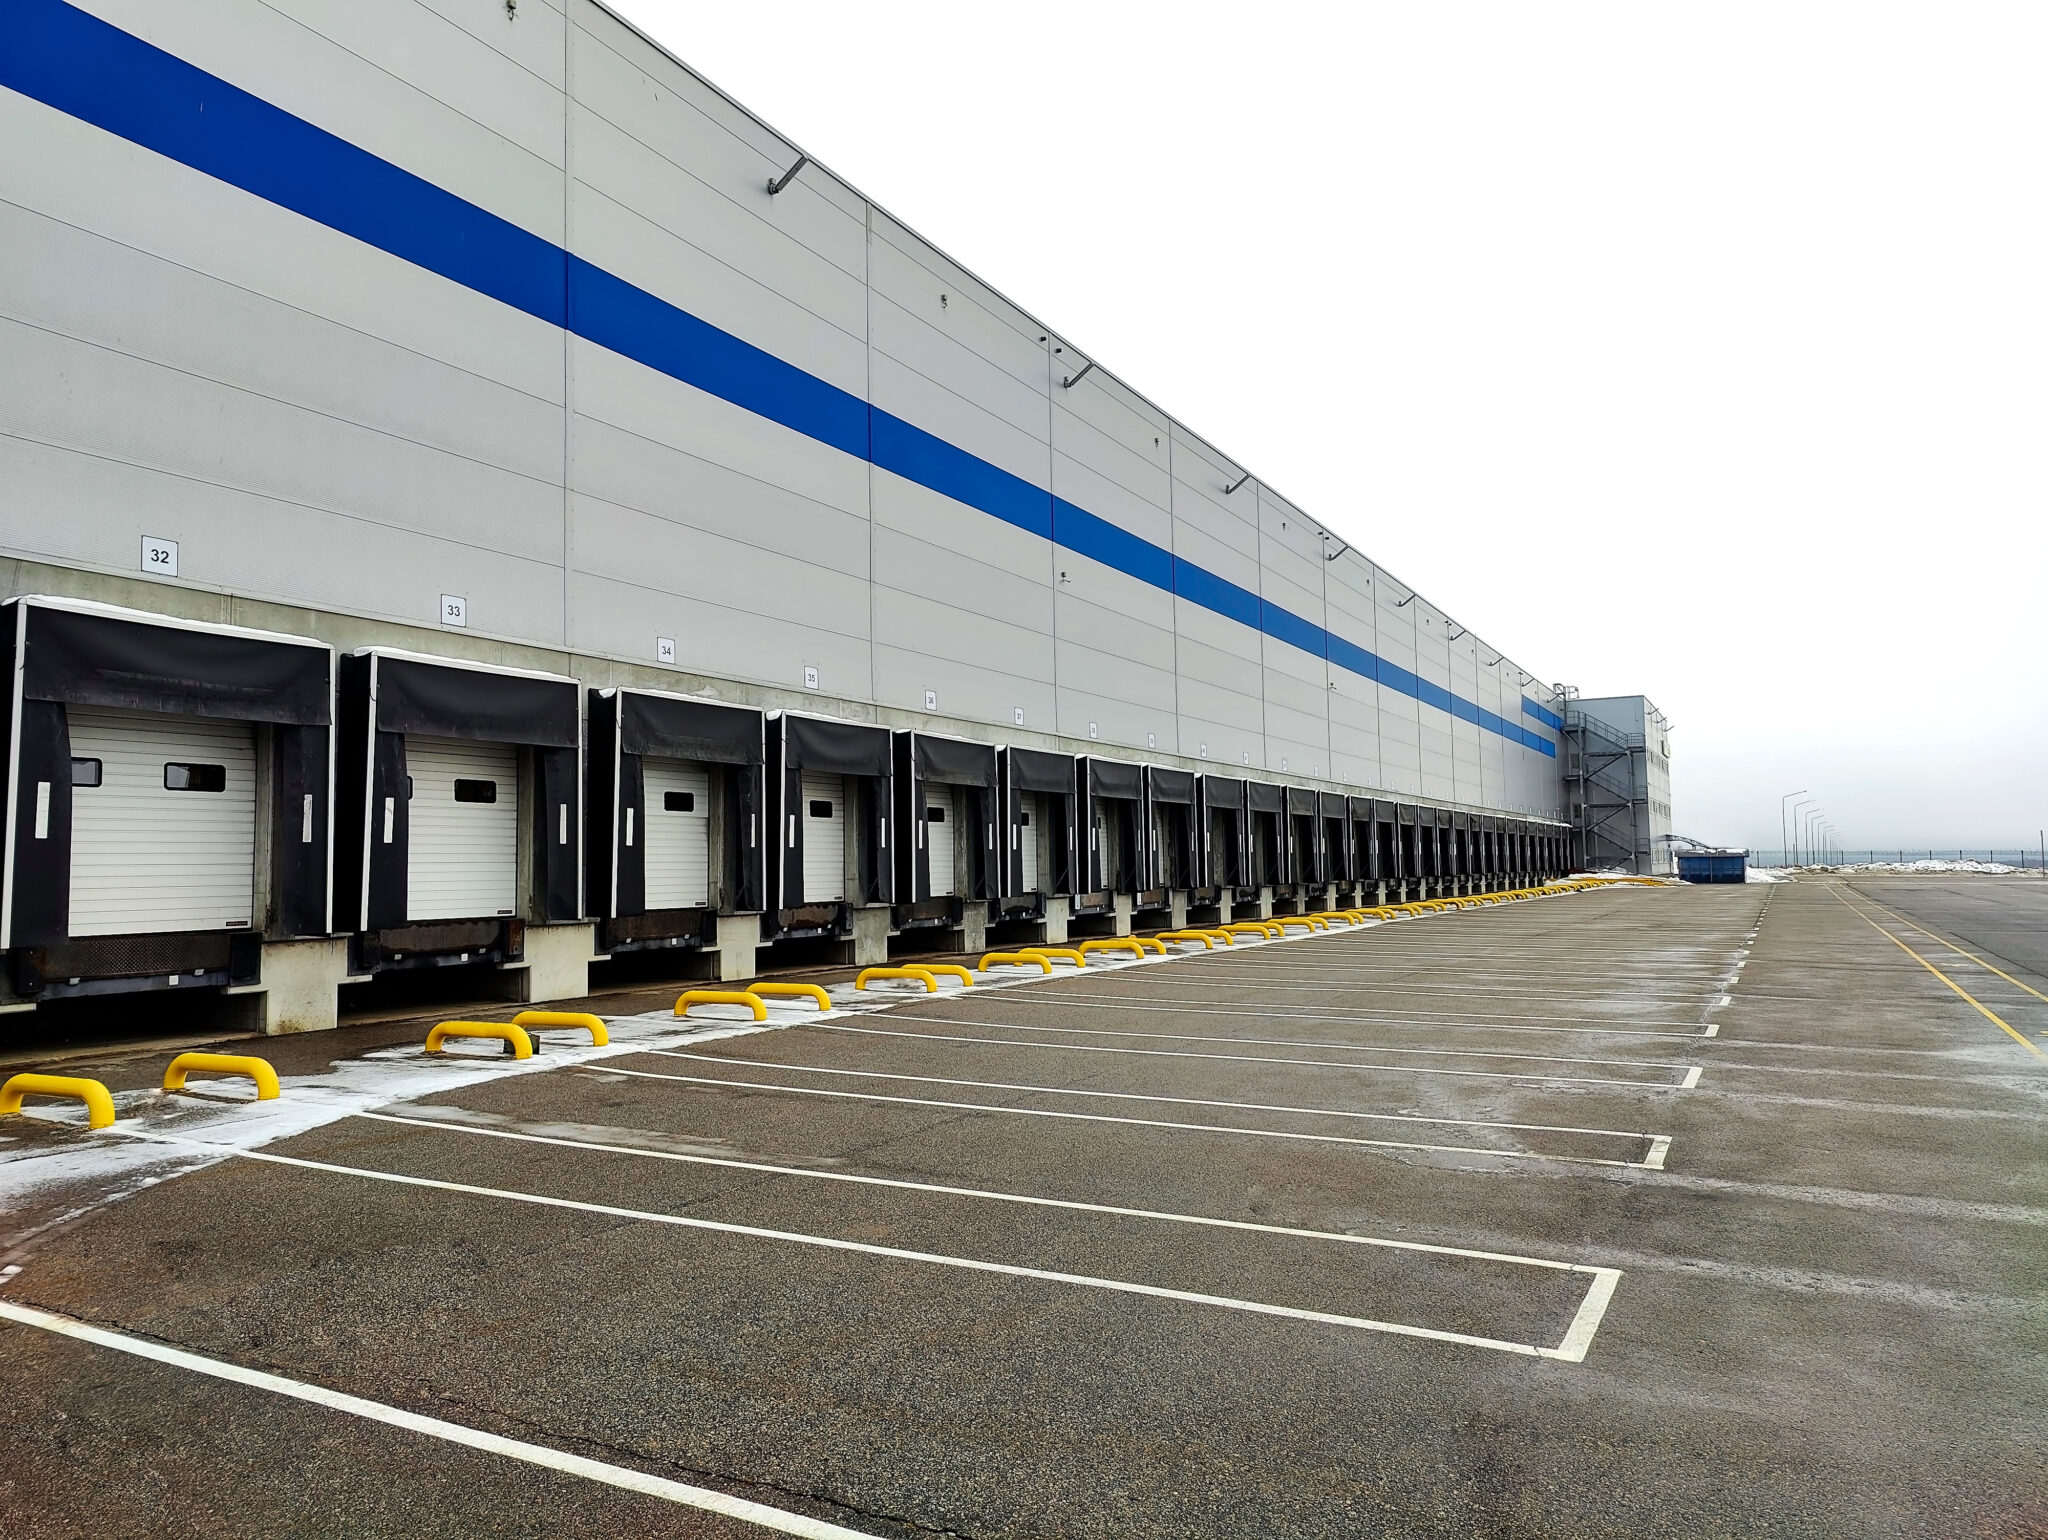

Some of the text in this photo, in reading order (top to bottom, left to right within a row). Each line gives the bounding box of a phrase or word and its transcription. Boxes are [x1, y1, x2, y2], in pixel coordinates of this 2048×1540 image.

[151, 549, 169, 564] 32
[447, 605, 460, 617] 33
[661, 645, 671, 656] 34
[807, 673, 816, 682] 35
[928, 696, 934, 704] 36
